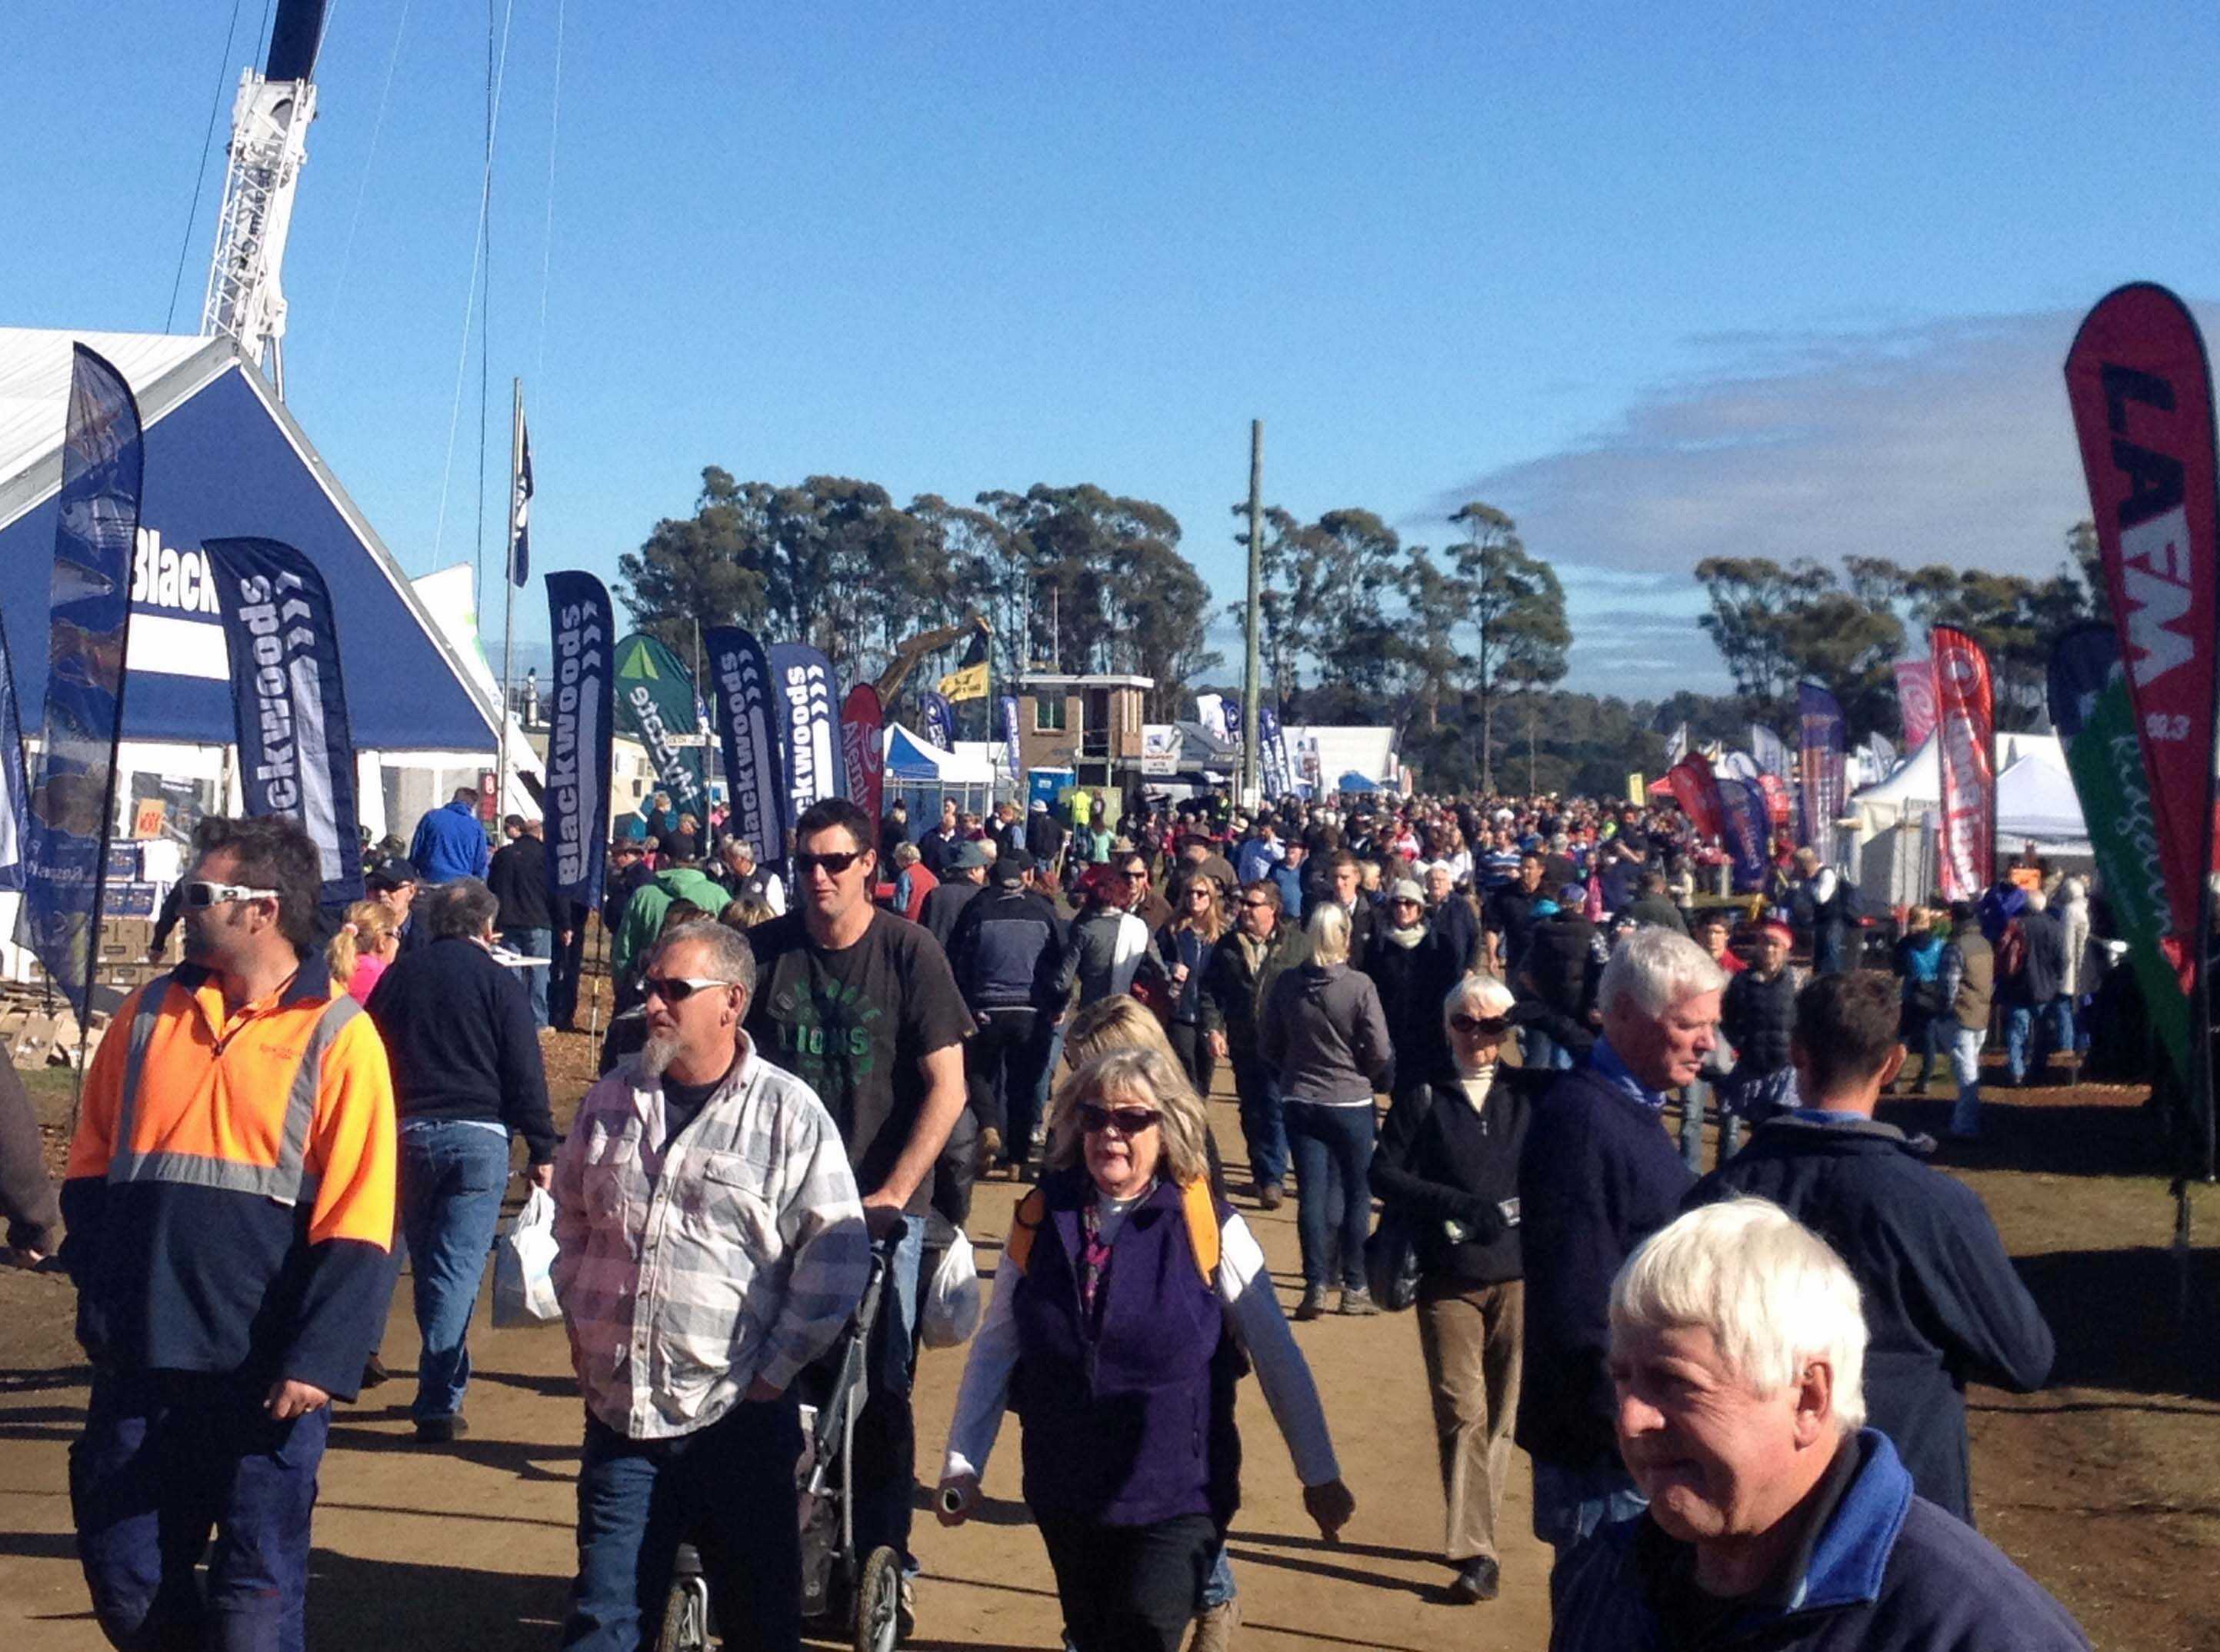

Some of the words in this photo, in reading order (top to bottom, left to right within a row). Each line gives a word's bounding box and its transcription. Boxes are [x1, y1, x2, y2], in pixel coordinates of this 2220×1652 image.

[239, 575, 290, 818] ckwoods
[551, 603, 581, 884] Blackwoods
[787, 665, 814, 815] ckwoods
